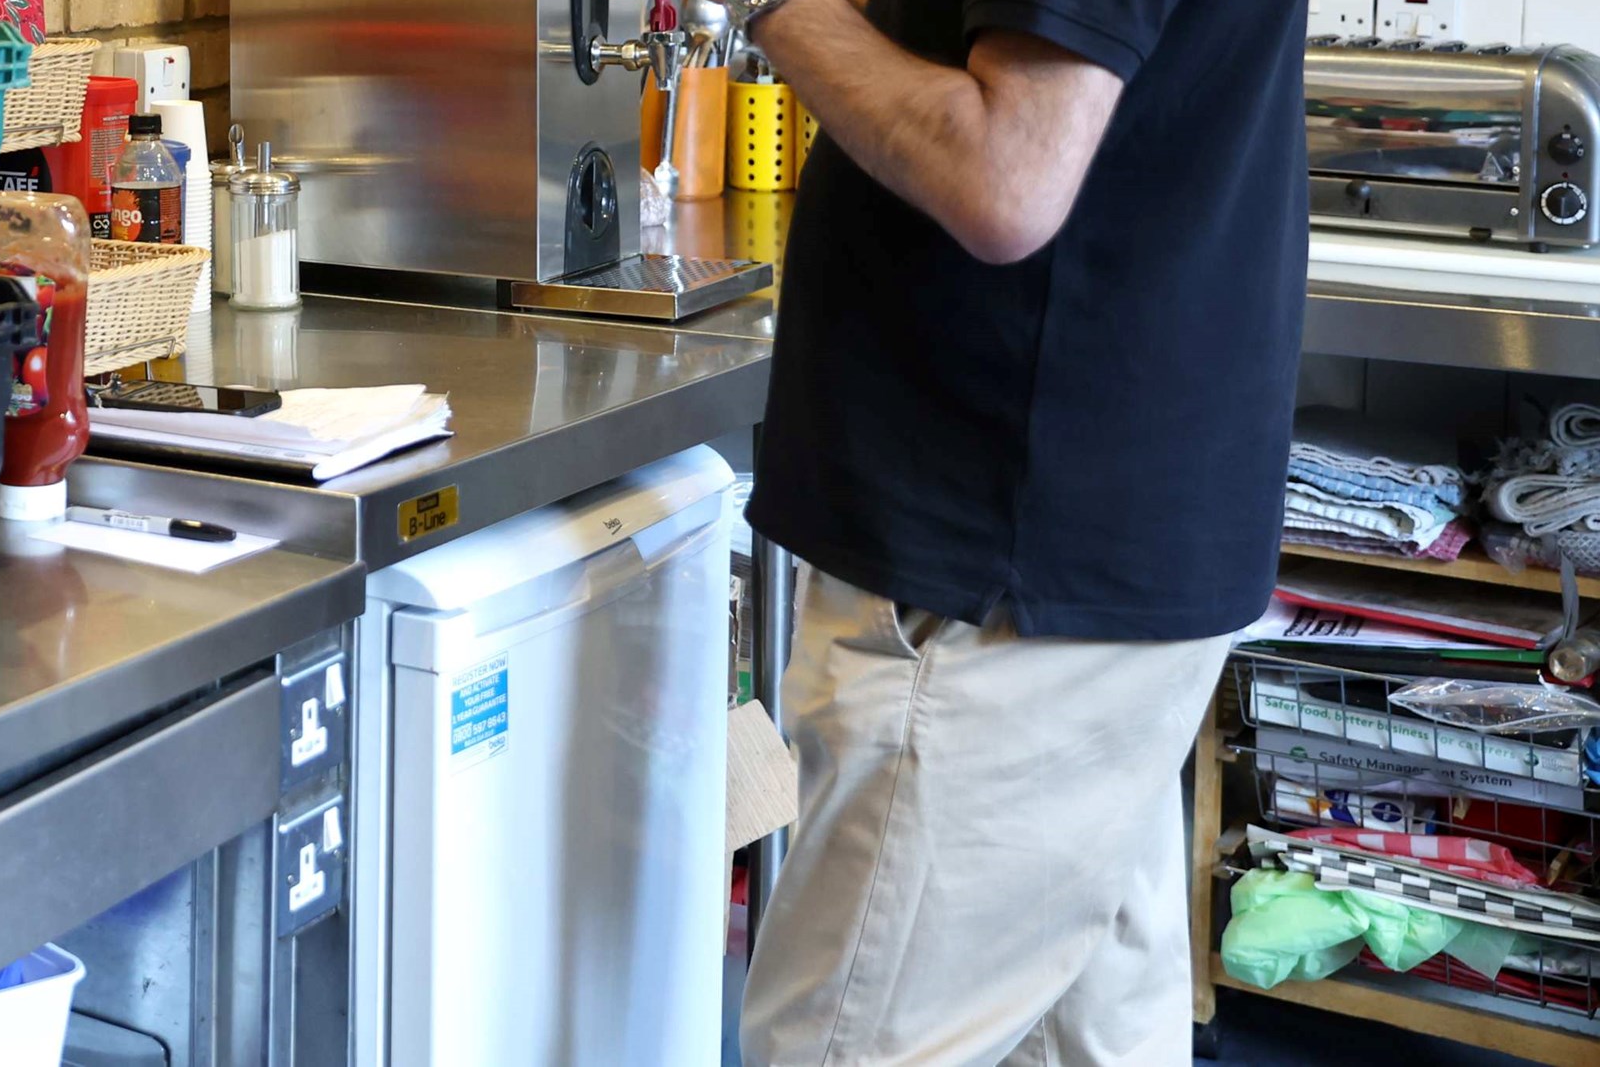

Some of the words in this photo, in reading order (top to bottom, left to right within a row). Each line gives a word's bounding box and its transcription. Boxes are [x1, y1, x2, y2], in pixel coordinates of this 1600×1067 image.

[409, 510, 446, 536] B-Line
[603, 517, 622, 530] beko
[452, 665, 487, 686] REGISTER
[489, 659, 506, 672] NOW
[1264, 696, 1296, 711] Safer
[1335, 711, 1374, 729] btter
[1458, 739, 1516, 759] catrers
[1319, 752, 1362, 768] Safety
[1460, 770, 1512, 787] System
